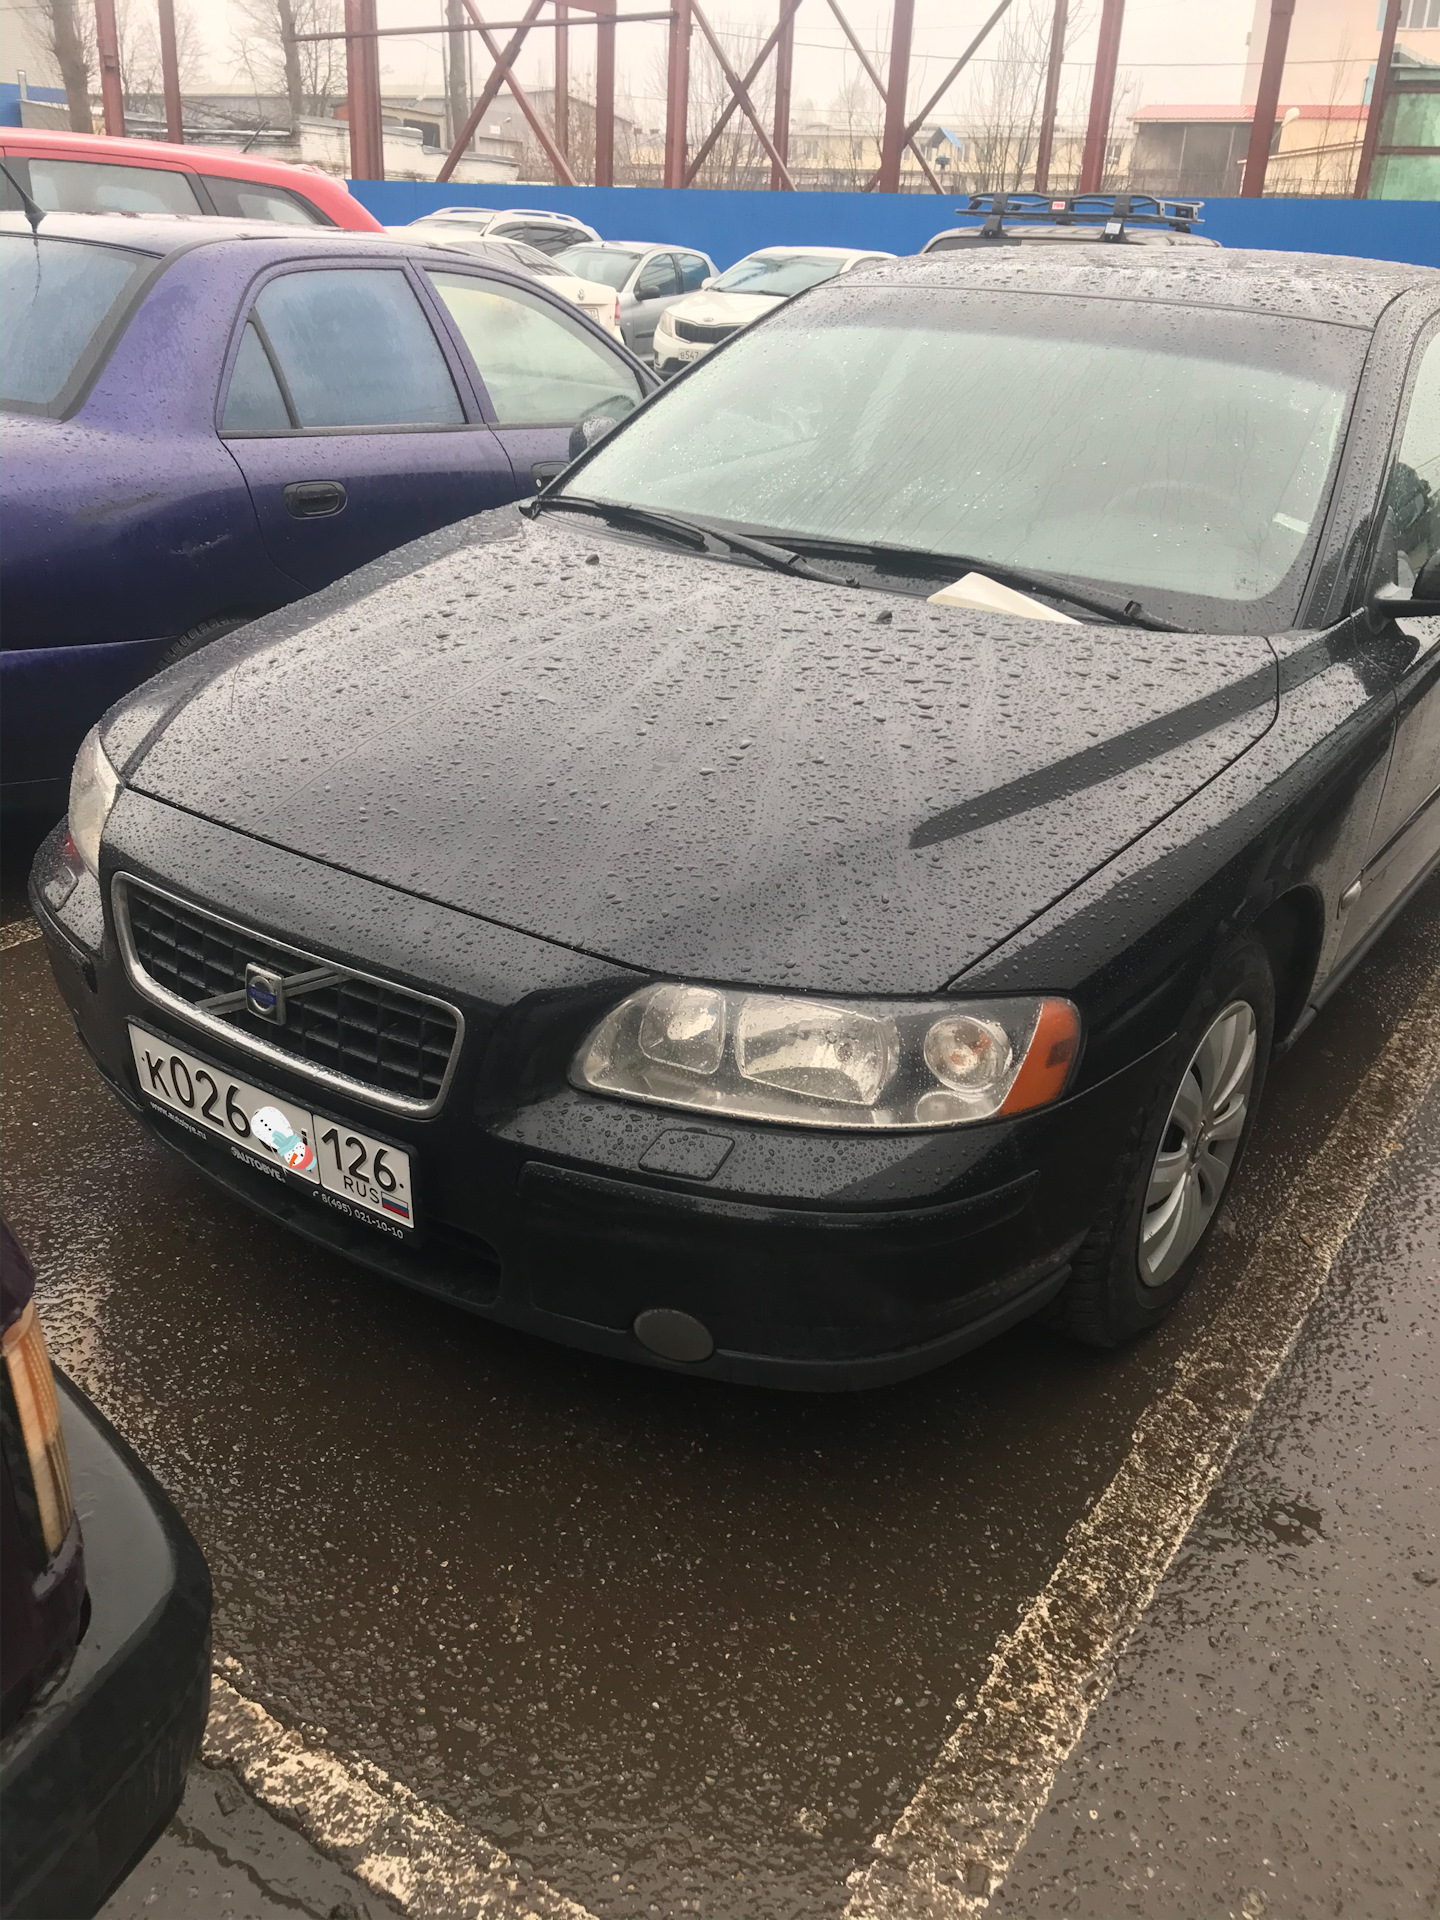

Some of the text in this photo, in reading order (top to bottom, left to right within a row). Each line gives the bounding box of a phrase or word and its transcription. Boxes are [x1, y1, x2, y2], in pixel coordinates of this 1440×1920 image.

[144, 1050, 397, 1192] К026 126
[343, 1175, 380, 1204] RUS
